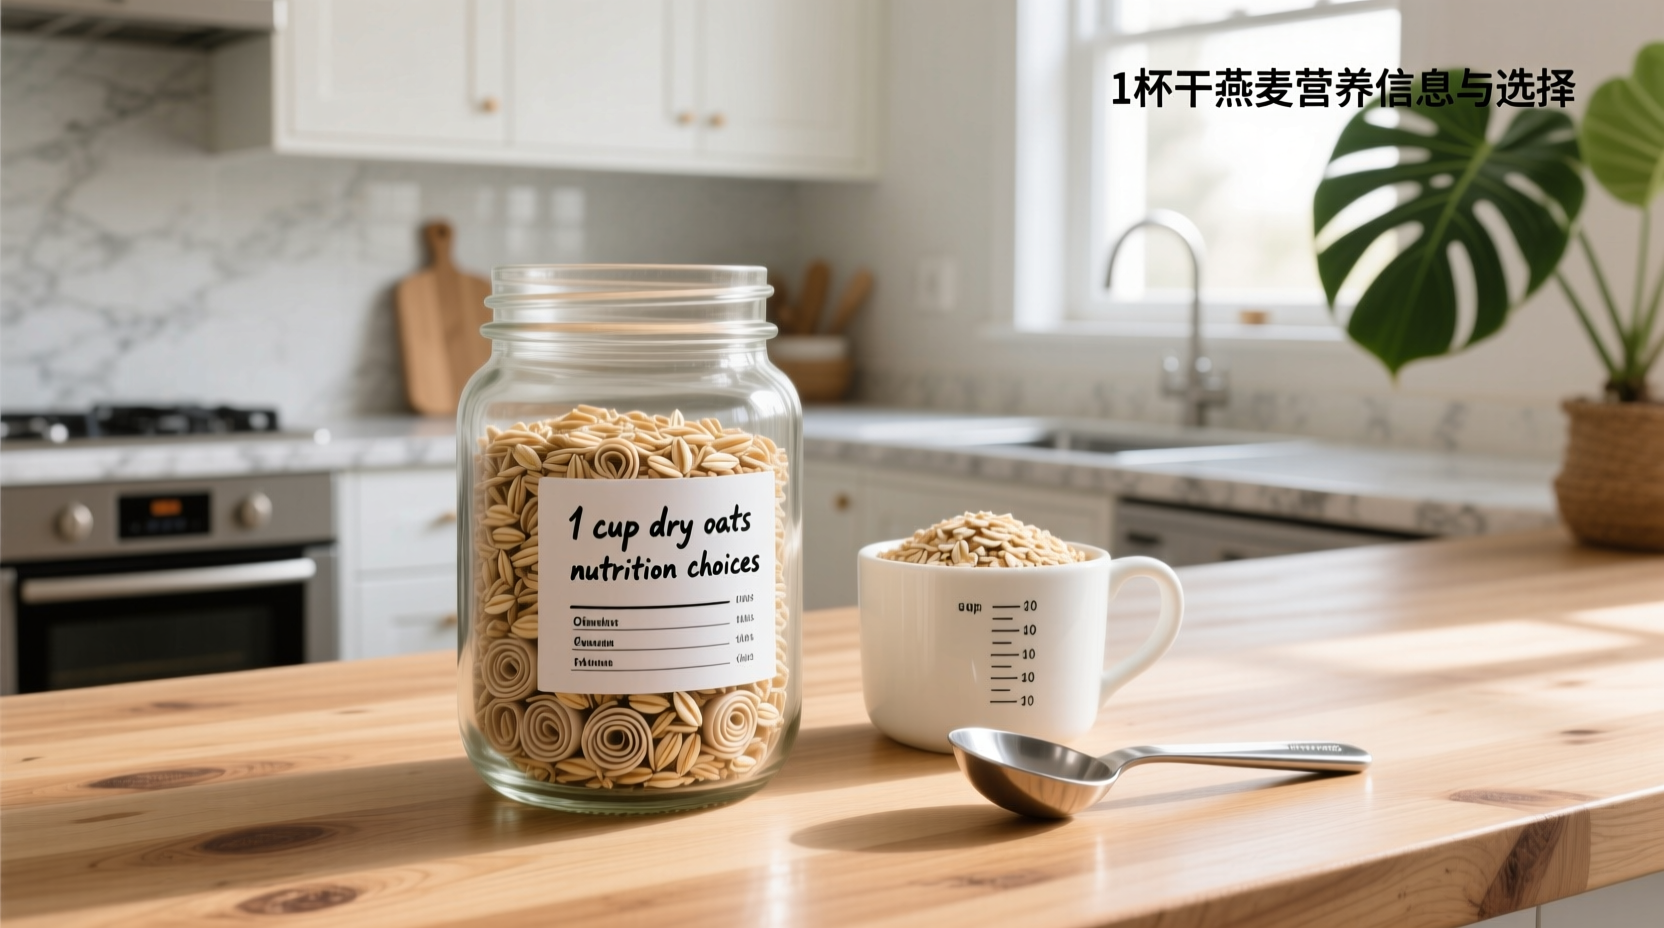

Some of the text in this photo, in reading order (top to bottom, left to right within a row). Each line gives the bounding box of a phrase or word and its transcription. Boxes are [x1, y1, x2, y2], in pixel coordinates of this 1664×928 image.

[568, 503, 752, 553] 1 cup dry oats
[570, 549, 760, 582] nutrition choices
[1022, 648, 1036, 660] 10
[1021, 671, 1036, 683] 10
